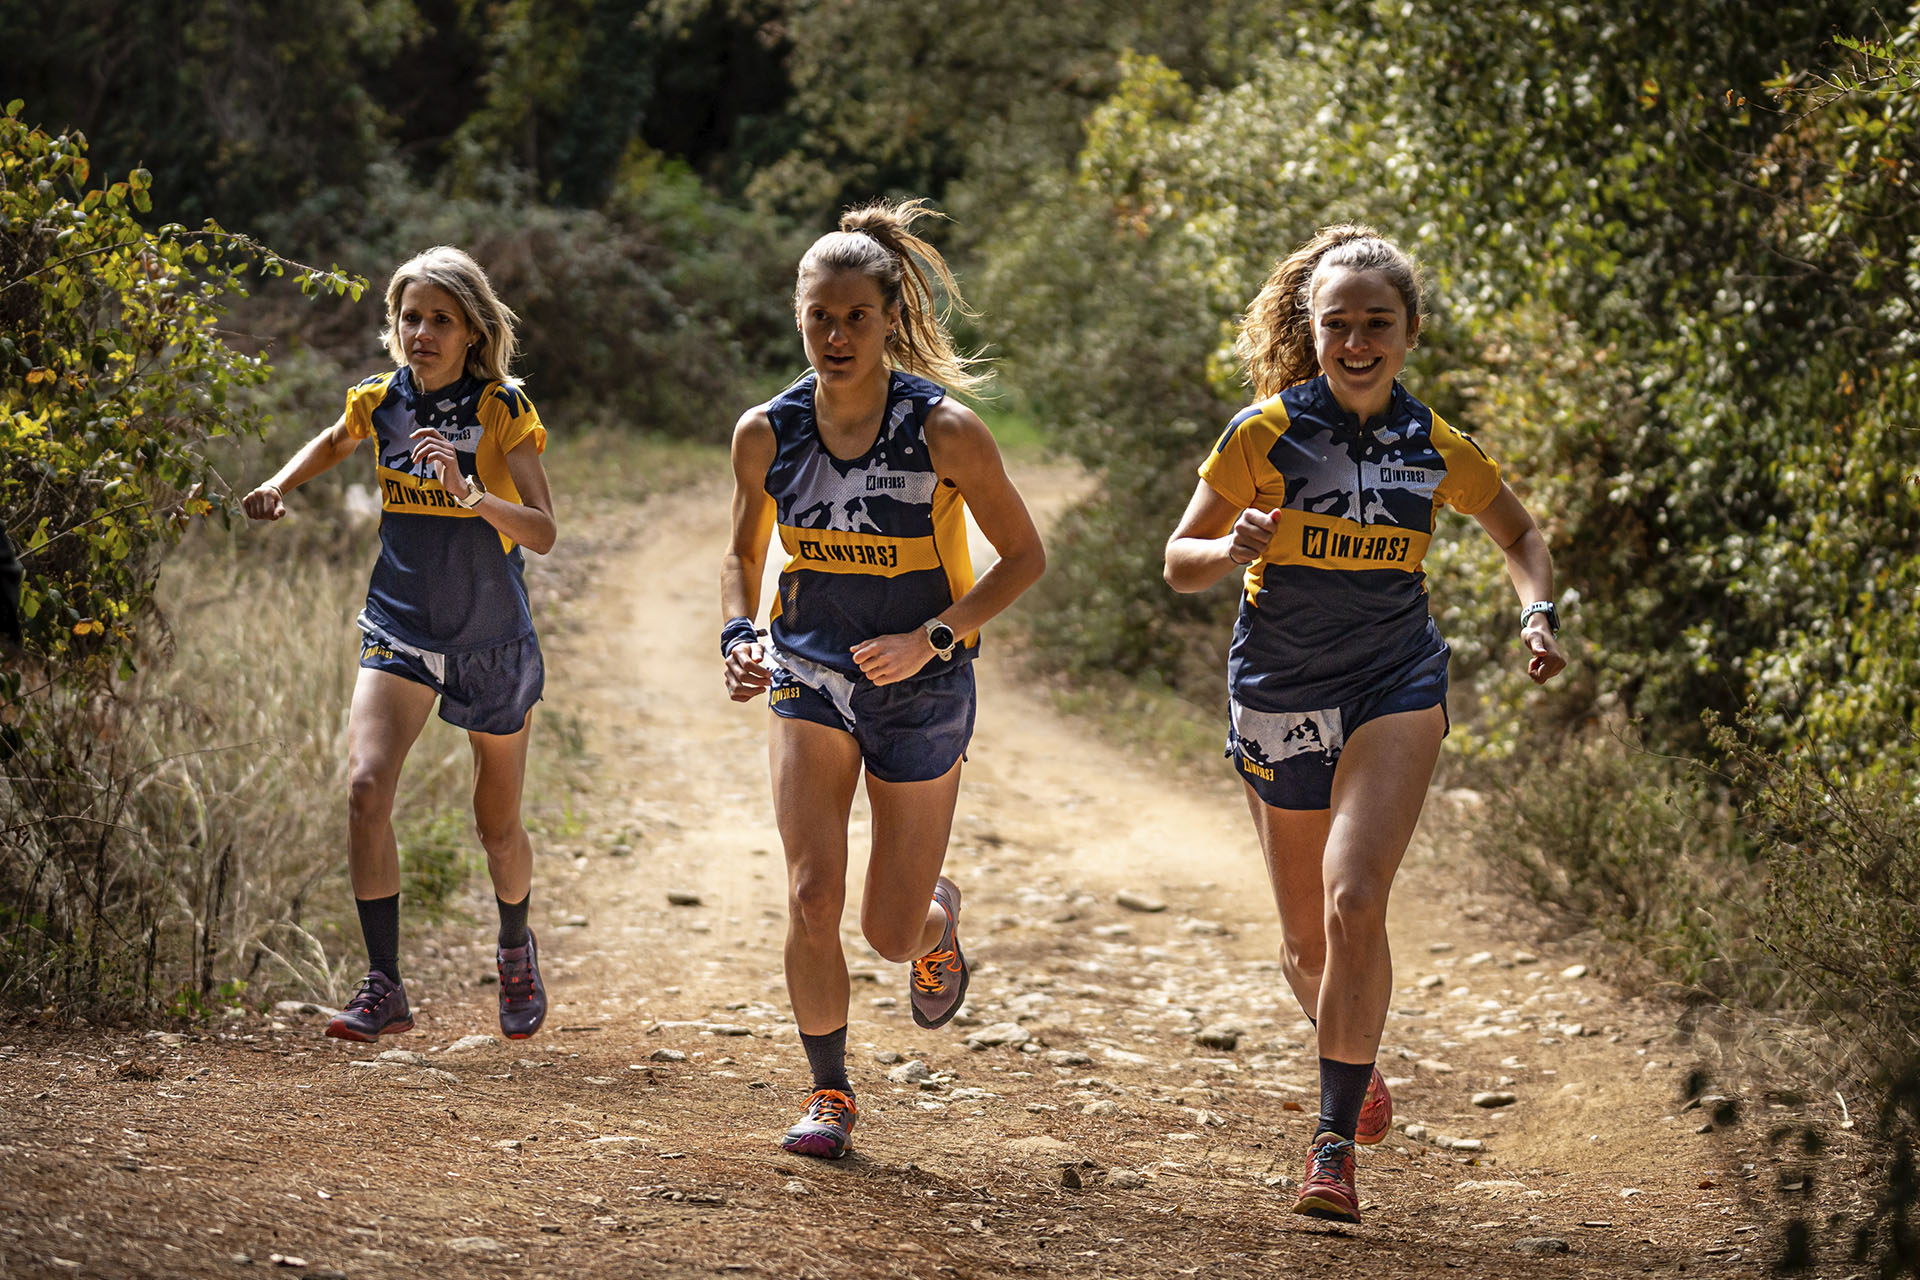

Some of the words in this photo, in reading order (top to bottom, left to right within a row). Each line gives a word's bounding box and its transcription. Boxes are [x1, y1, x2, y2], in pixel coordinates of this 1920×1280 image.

[1393, 470, 1425, 483] INVERSE
[403, 487, 464, 508] INVERS
[825, 545, 897, 568] INVERSE
[1331, 533, 1410, 562] INVERSE
